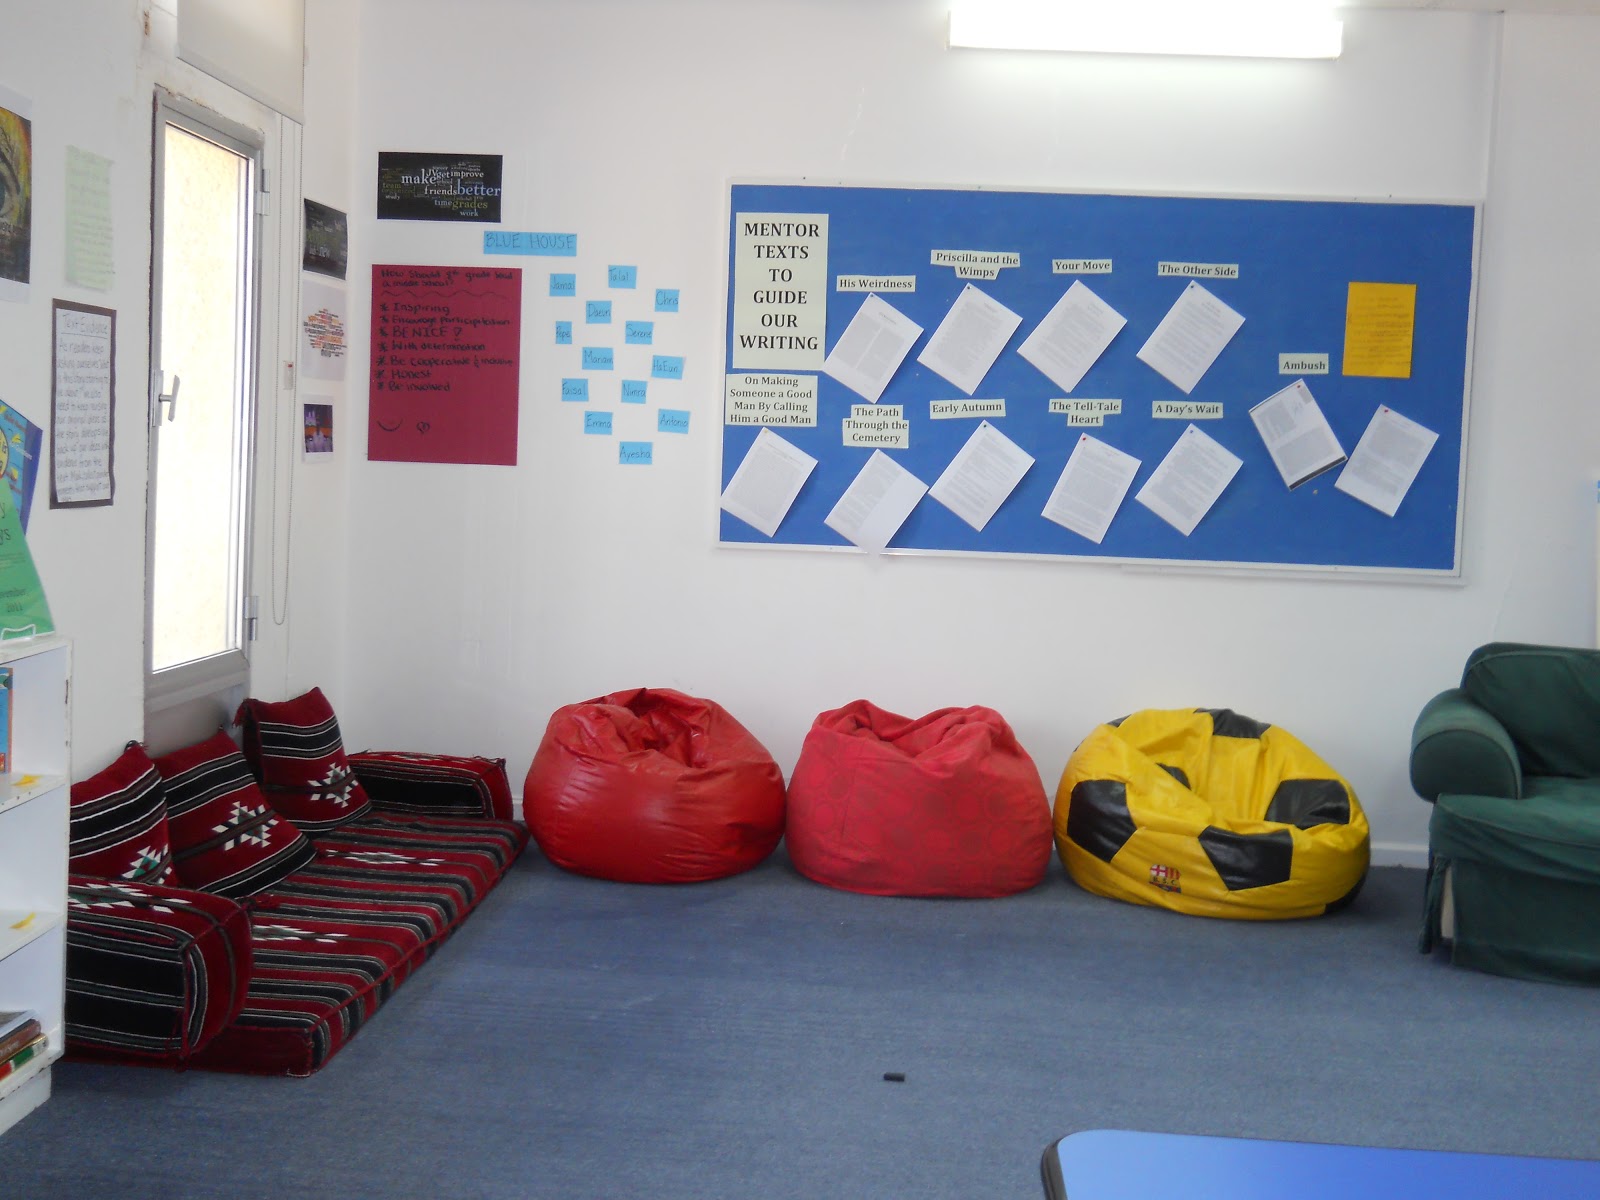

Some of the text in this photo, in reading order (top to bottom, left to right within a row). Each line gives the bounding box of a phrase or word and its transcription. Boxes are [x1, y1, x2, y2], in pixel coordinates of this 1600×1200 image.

[401, 168, 438, 185] make
[450, 170, 485, 179] improve
[424, 185, 458, 195] friends
[457, 179, 501, 196] better
[451, 196, 488, 210] grades
[459, 209, 479, 217] work
[744, 223, 820, 237] MENTOR
[486, 233, 575, 249] BLUE HOUSE
[754, 245, 809, 259] TEXTS
[936, 252, 1019, 265] Priscilla and the
[1055, 261, 1110, 270] Your Move
[1160, 264, 1236, 276] The Other Side
[608, 267, 629, 281] Talal
[769, 268, 793, 282] TO
[959, 267, 995, 278] Wimps
[551, 277, 575, 290] Jamal
[839, 279, 913, 289] His Weirdness
[655, 292, 679, 306] Chris
[753, 290, 808, 305] GUIDE
[393, 303, 450, 315] Inspiring
[761, 313, 798, 328] OUR
[392, 326, 448, 338] BE NICE
[739, 335, 818, 350] WRITING
[1282, 361, 1326, 370] Ambush
[744, 376, 799, 387] On Making
[730, 389, 776, 398] Someone
[786, 389, 812, 398] Good
[734, 402, 808, 413] Man By Calling
[855, 407, 899, 416] The Path
[932, 403, 1002, 414] Early Autumn
[1052, 401, 1120, 411] The Tell-Tale
[1155, 404, 1163, 412] A
[1195, 404, 1220, 413] Wait
[586, 413, 612, 428] Emma
[730, 414, 751, 423] Him
[761, 415, 787, 424] Good
[790, 415, 811, 424] Man
[1070, 414, 1100, 423] Heart
[845, 420, 908, 431] Through the
[852, 433, 901, 443] Cemetery
[620, 447, 652, 462] Ayesha
